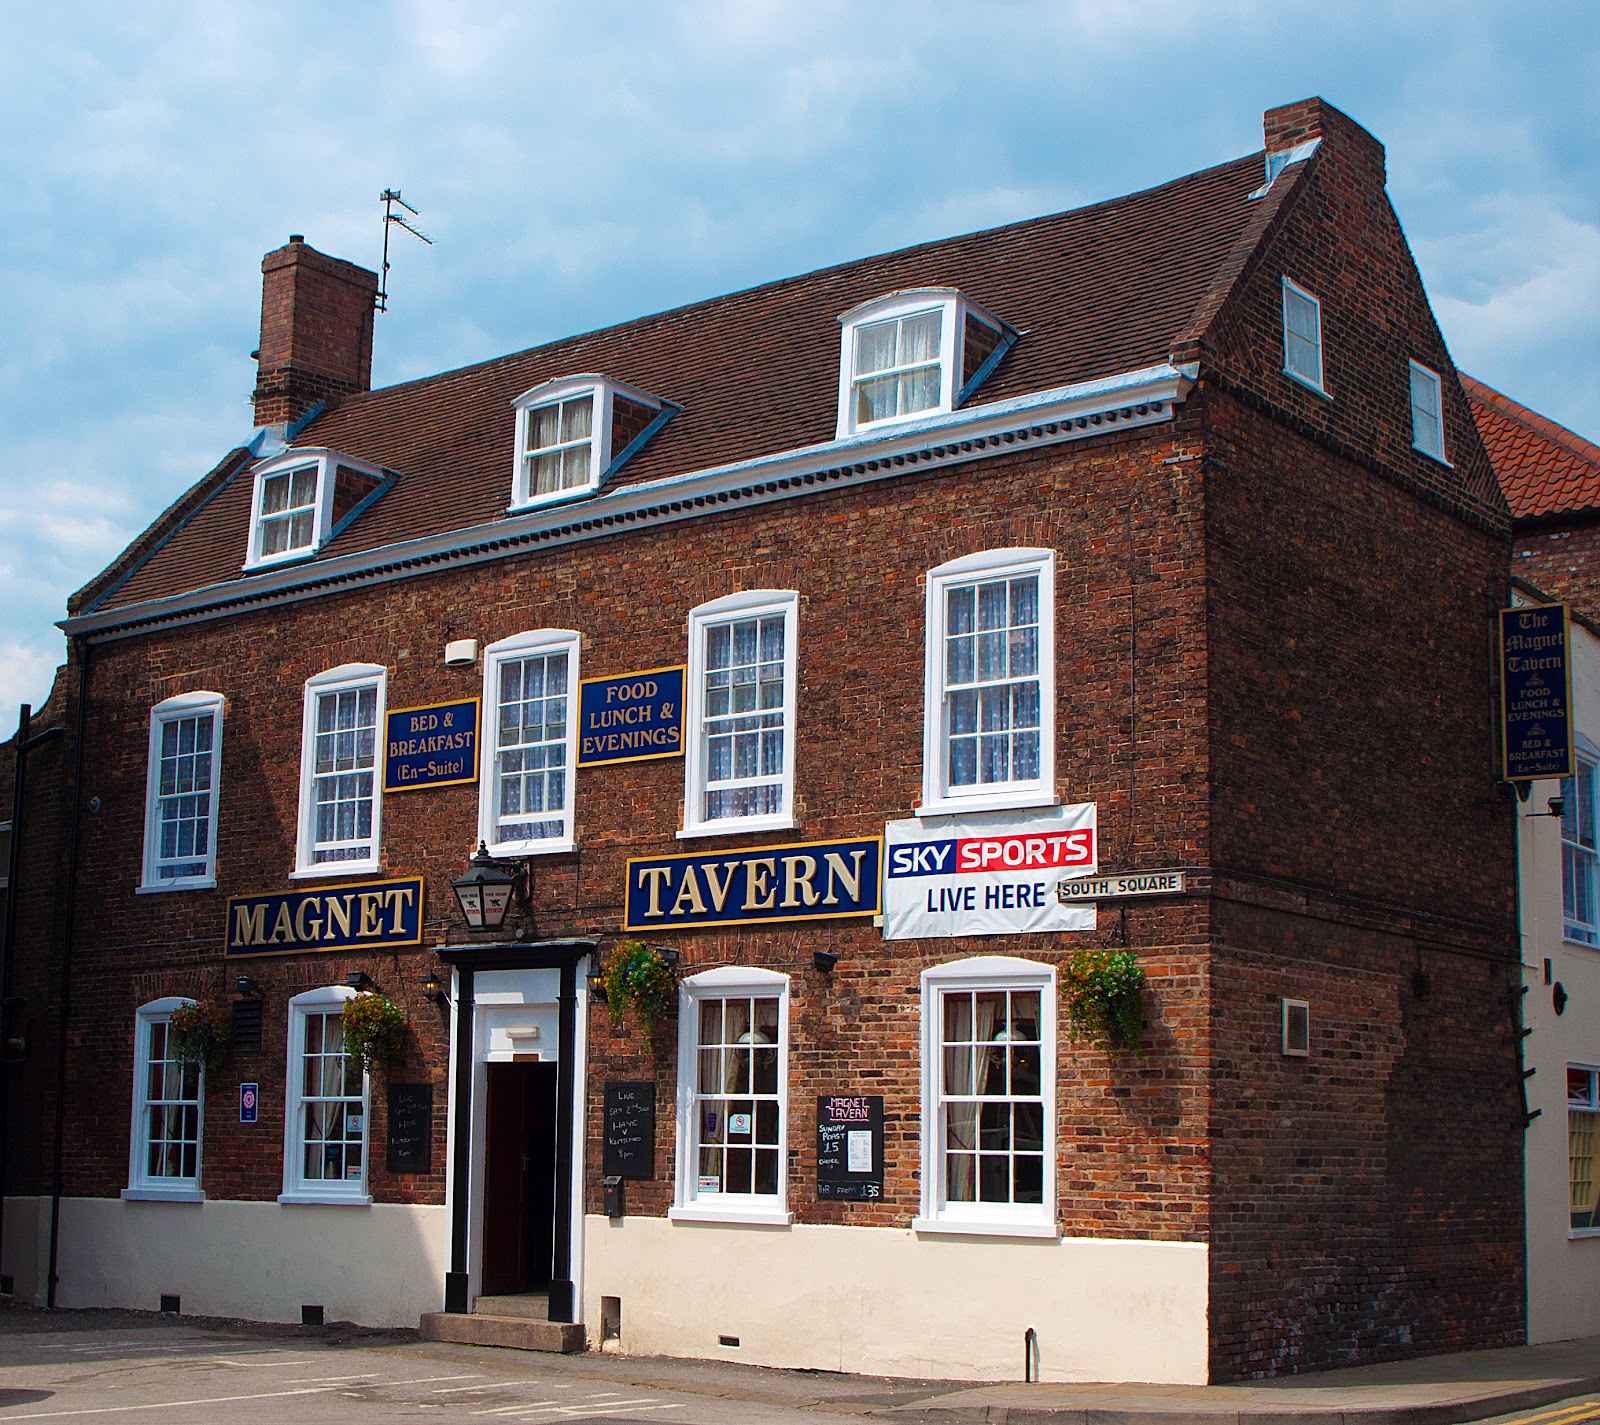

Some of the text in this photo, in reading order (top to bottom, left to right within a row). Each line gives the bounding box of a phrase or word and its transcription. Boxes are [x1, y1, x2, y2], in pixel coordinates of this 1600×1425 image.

[1518, 613, 1548, 629] The
[1504, 632, 1564, 652] Magnet
[1508, 656, 1562, 673] Tavern
[606, 681, 658, 703] FOOD
[1520, 687, 1551, 698] FOOD
[1507, 708, 1565, 721] EVENINGS
[1511, 698, 1560, 711] LUNCH &
[410, 711, 454, 733] BED &
[589, 702, 674, 729] LUNCH &
[389, 731, 474, 758] BREAKFAST
[582, 725, 680, 754] EVENINGS
[1522, 739, 1541, 749] BED
[1508, 749, 1565, 761] BREAKFAST
[397, 757, 464, 782] (En-Suite)
[892, 834, 1088, 873] SKY SPORTS
[638, 849, 868, 917] TAVERN
[1063, 875, 1177, 896] SOUTH SQUARE
[927, 882, 1046, 912] LIVE HERE
[231, 888, 414, 947] MAGNET
[830, 1097, 867, 1108] MAGNET
[830, 1107, 868, 1118] TAVERN
[819, 1124, 845, 1133] SUNDAY
[822, 1132, 845, 1141] ROAST
